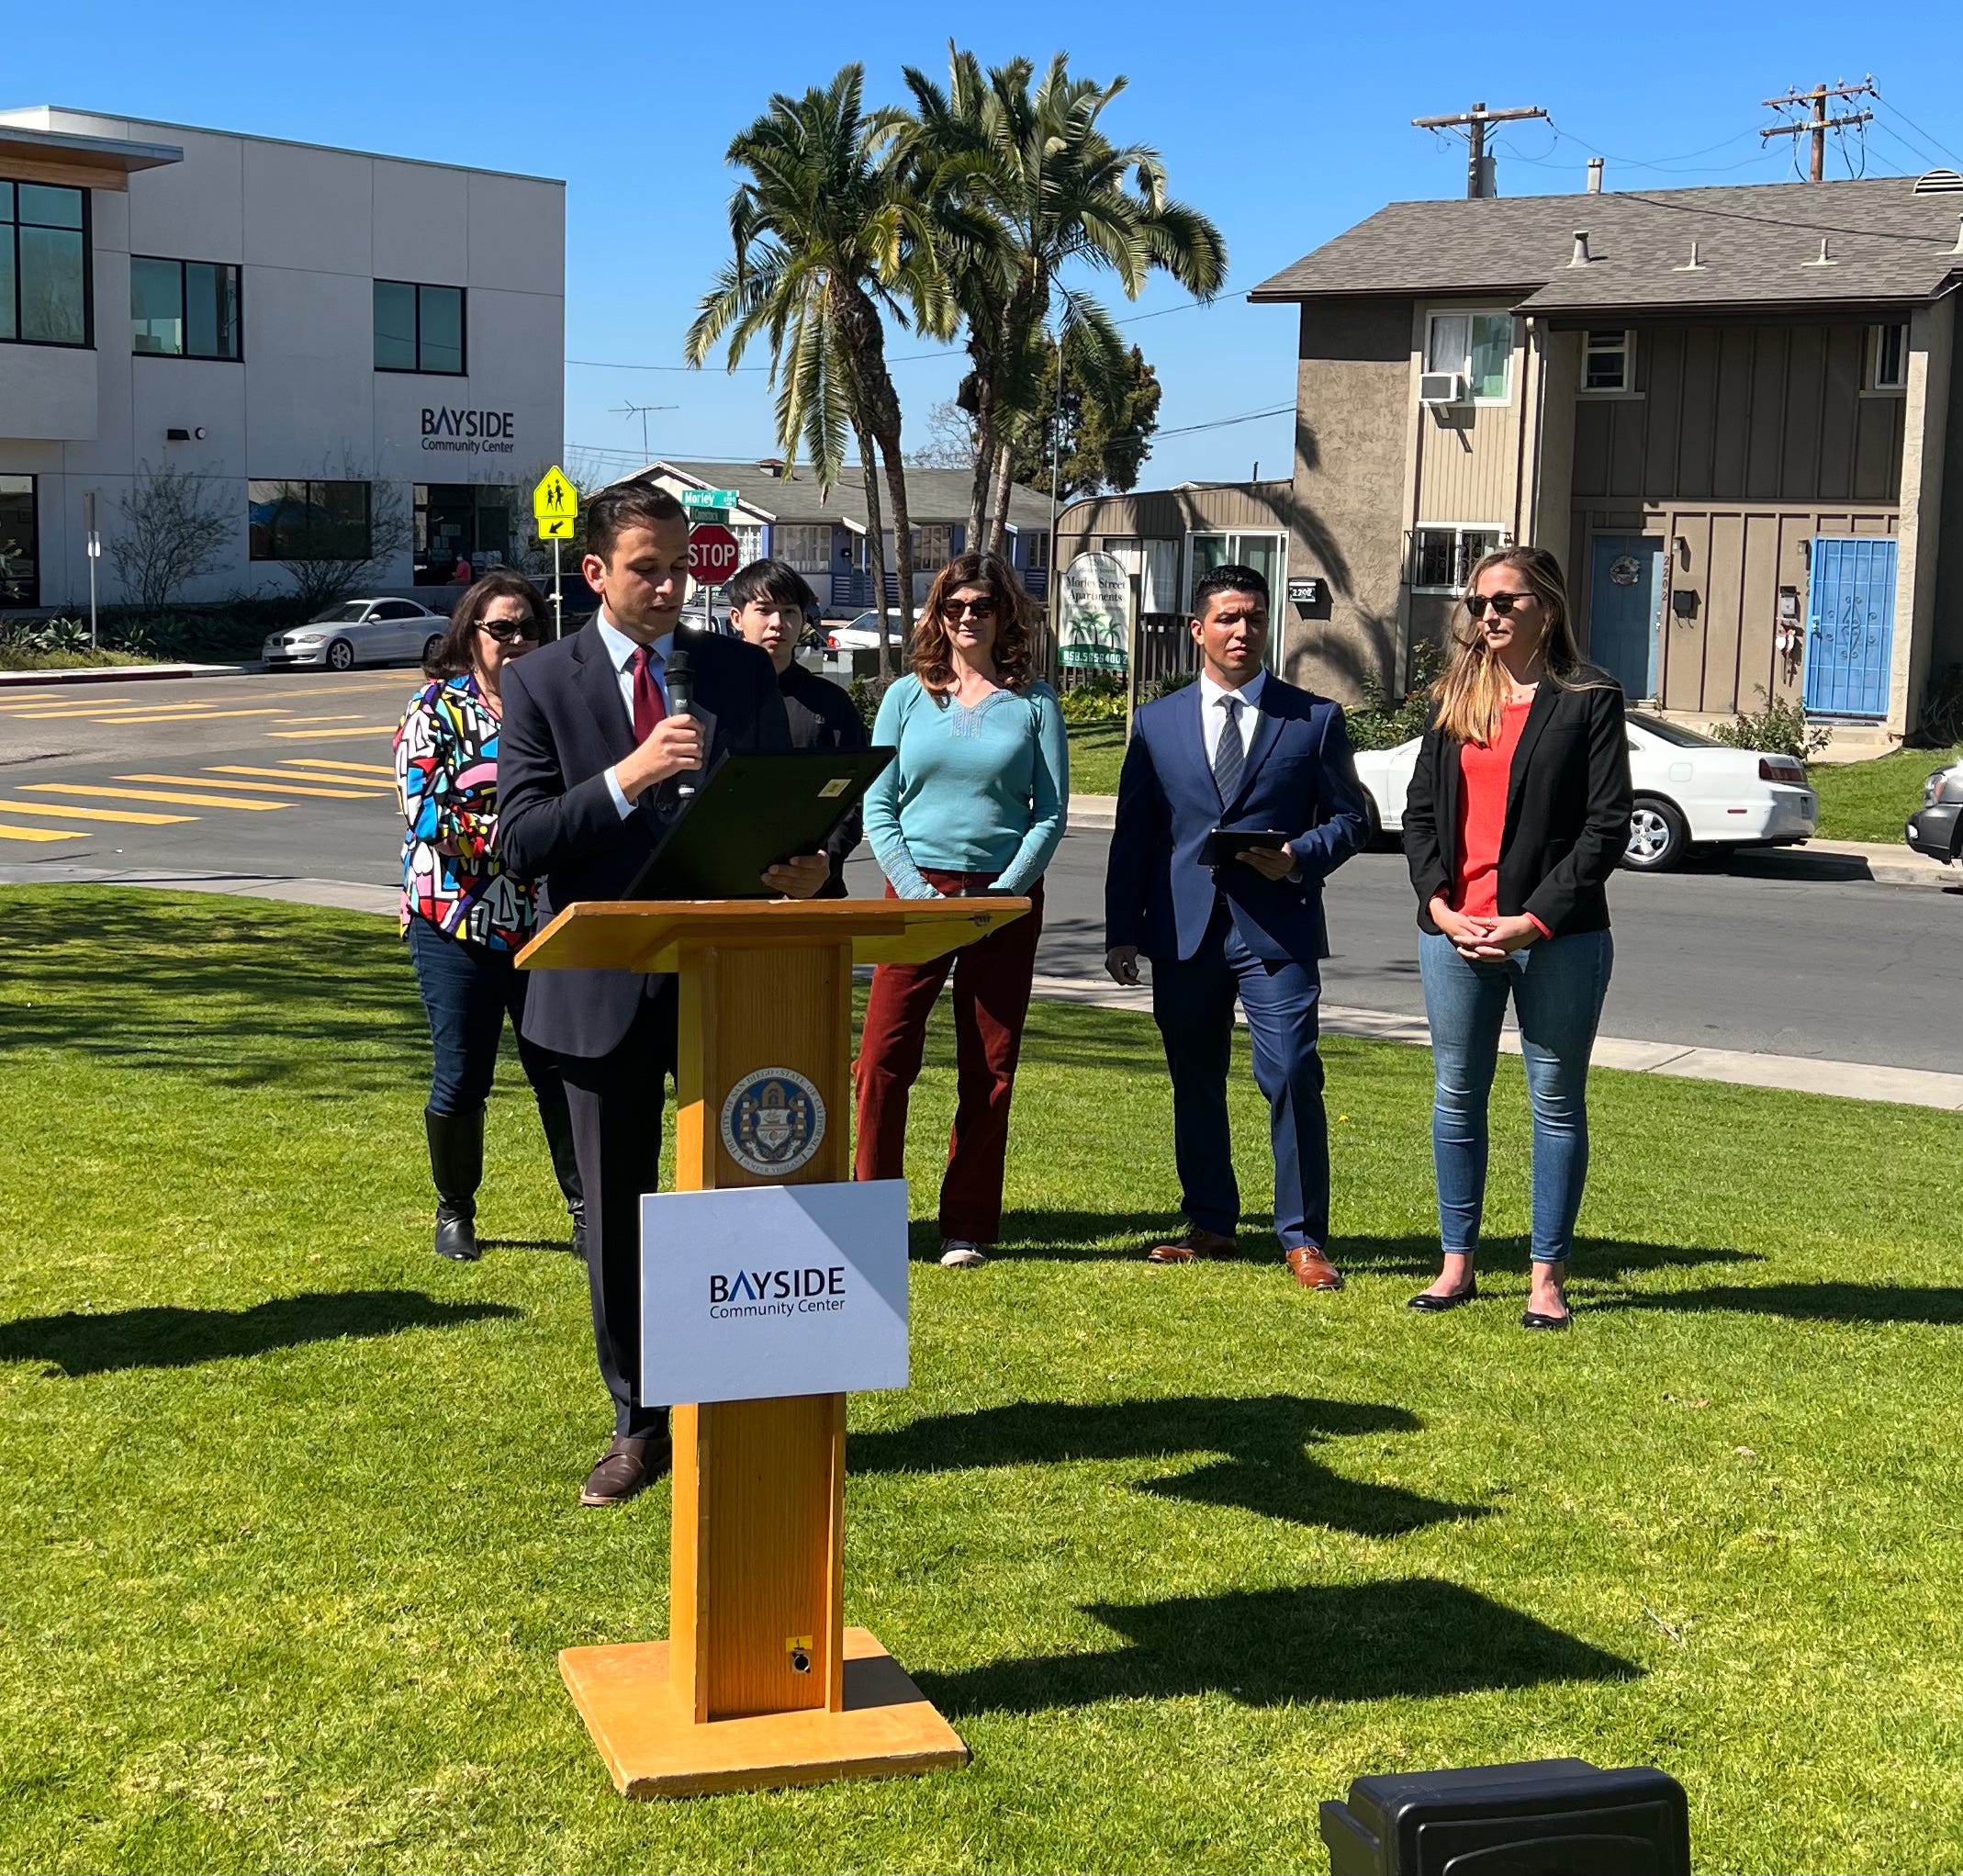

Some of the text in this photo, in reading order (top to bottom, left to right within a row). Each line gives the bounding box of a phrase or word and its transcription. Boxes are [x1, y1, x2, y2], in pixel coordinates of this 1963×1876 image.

[421, 405, 514, 438] BAYSIDE
[421, 438, 514, 455] Community Center
[685, 492, 714, 505] Morley
[688, 544, 735, 567] STOP
[710, 1266, 846, 1303] BAYSIDE
[710, 1298, 846, 1319] Community Center
